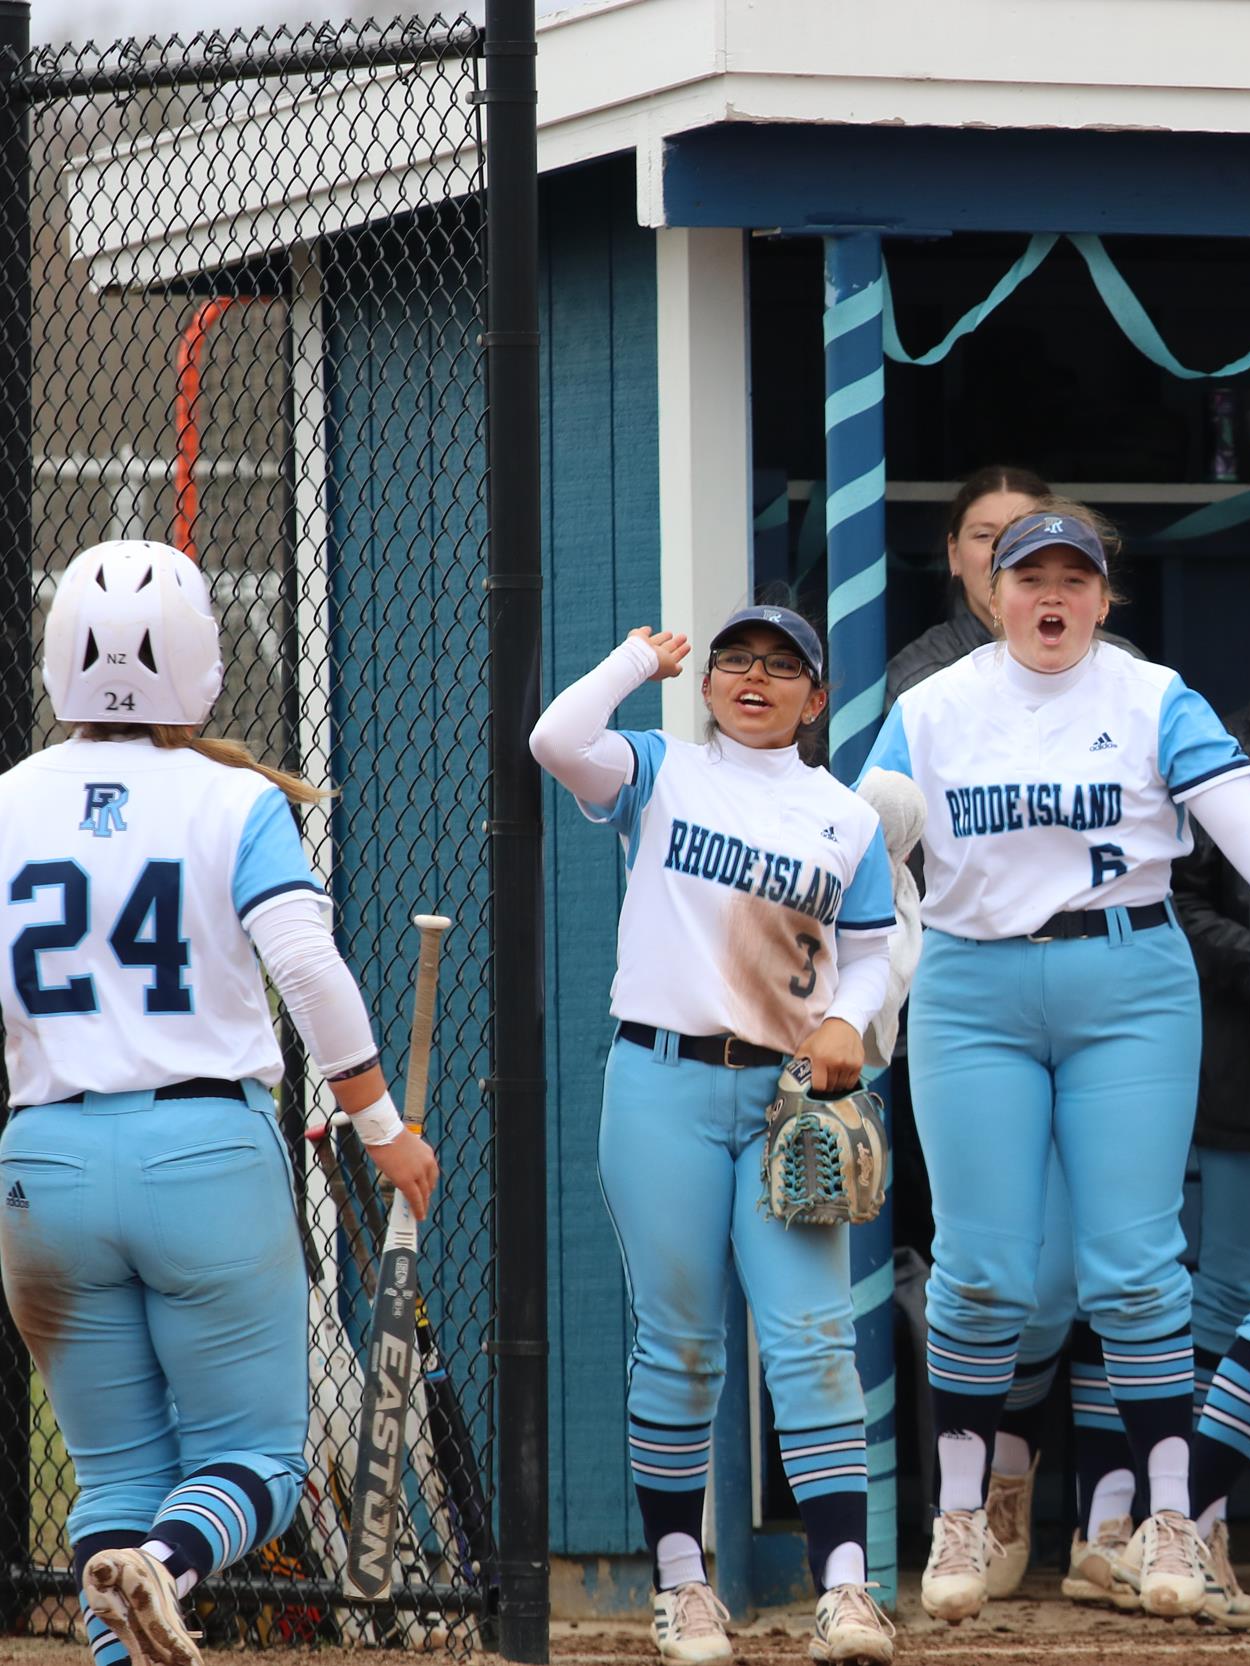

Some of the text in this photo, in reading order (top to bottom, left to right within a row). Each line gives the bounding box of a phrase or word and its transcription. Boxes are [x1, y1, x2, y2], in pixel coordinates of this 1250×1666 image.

[106, 653, 127, 665] NZ
[104, 691, 136, 711] 24
[945, 783, 1123, 838] RHODE ISLAND
[664, 818, 842, 926] RHODE ISLAND
[1088, 842, 1128, 888] 6
[8, 857, 195, 1018] 24
[789, 932, 821, 999] 3
[358, 1331, 407, 1582] EASTON
